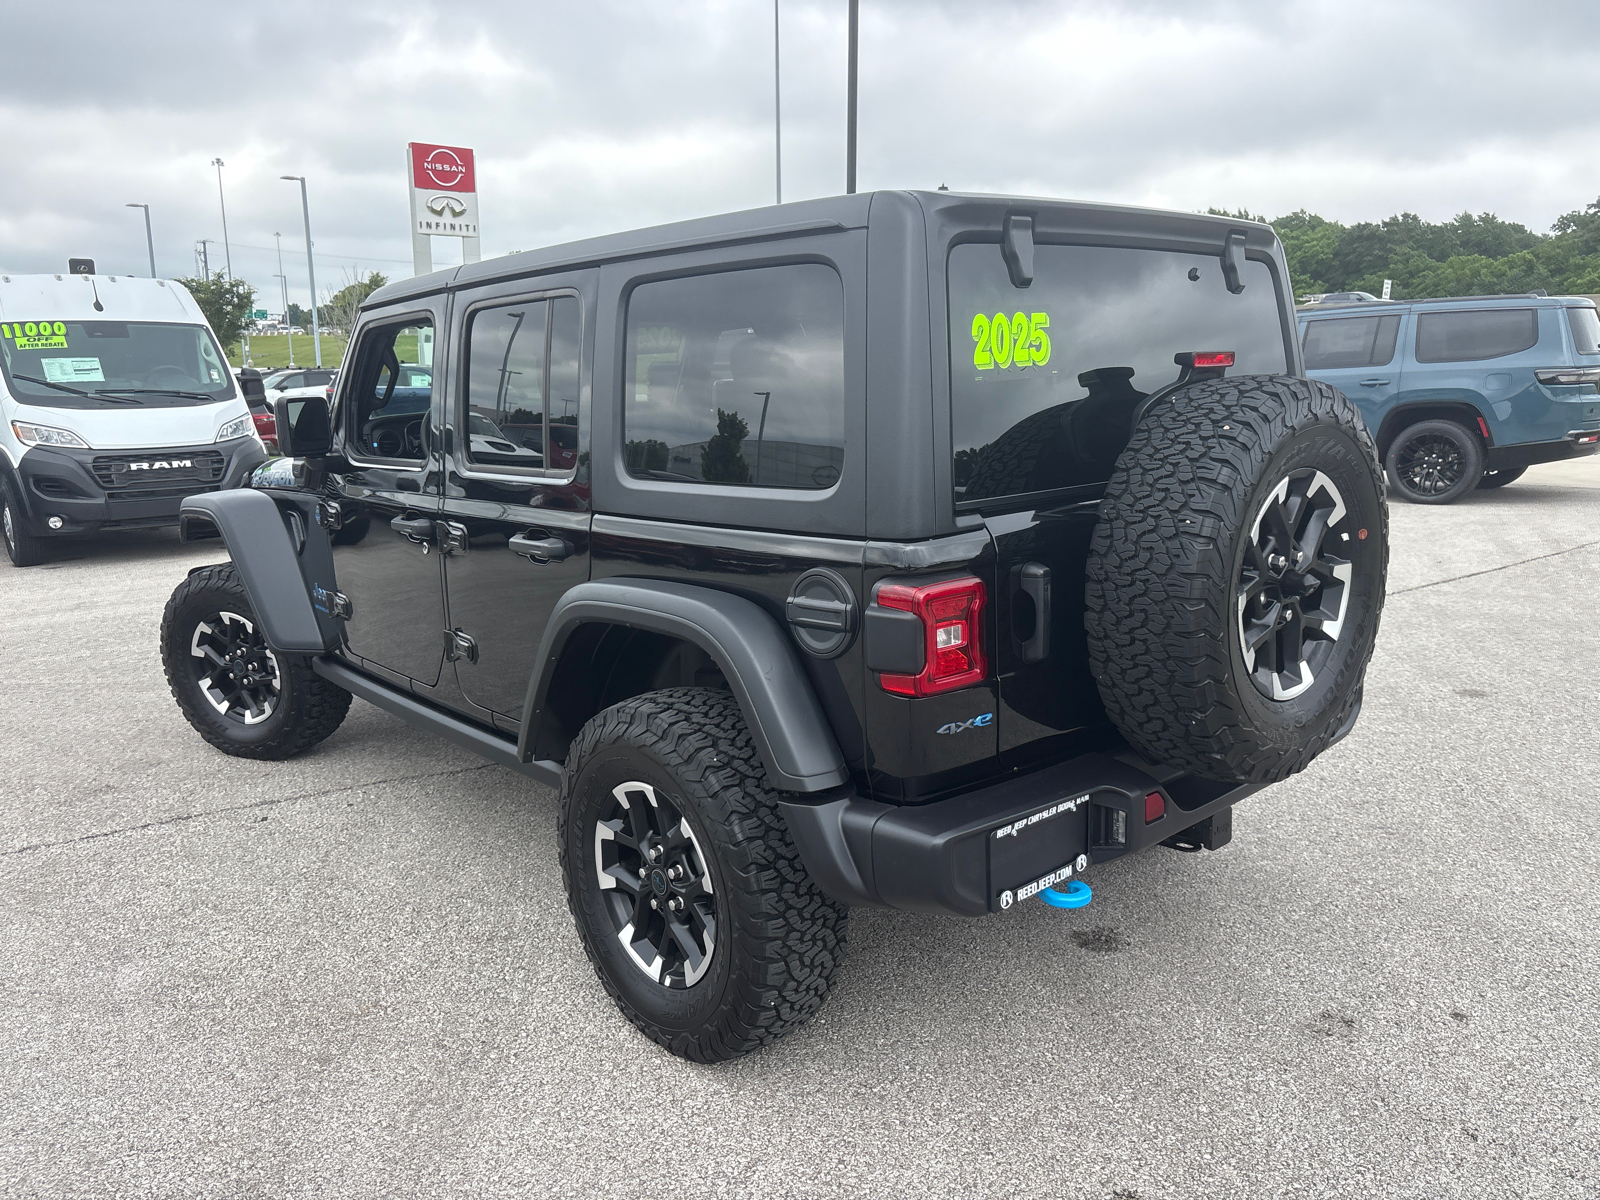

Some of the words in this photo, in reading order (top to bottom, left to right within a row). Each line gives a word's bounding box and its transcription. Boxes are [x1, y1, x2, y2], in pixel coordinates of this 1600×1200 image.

[424, 162, 466, 173] NISSAN
[419, 221, 476, 233] INFINITI
[972, 311, 1051, 370] 2025
[129, 460, 192, 470] RAM
[997, 825, 1012, 839] REED
[1013, 819, 1027, 830] JEEP
[1028, 806, 1057, 825] CHRYSLER
[1017, 864, 1073, 902] REEDJEEP.COM
